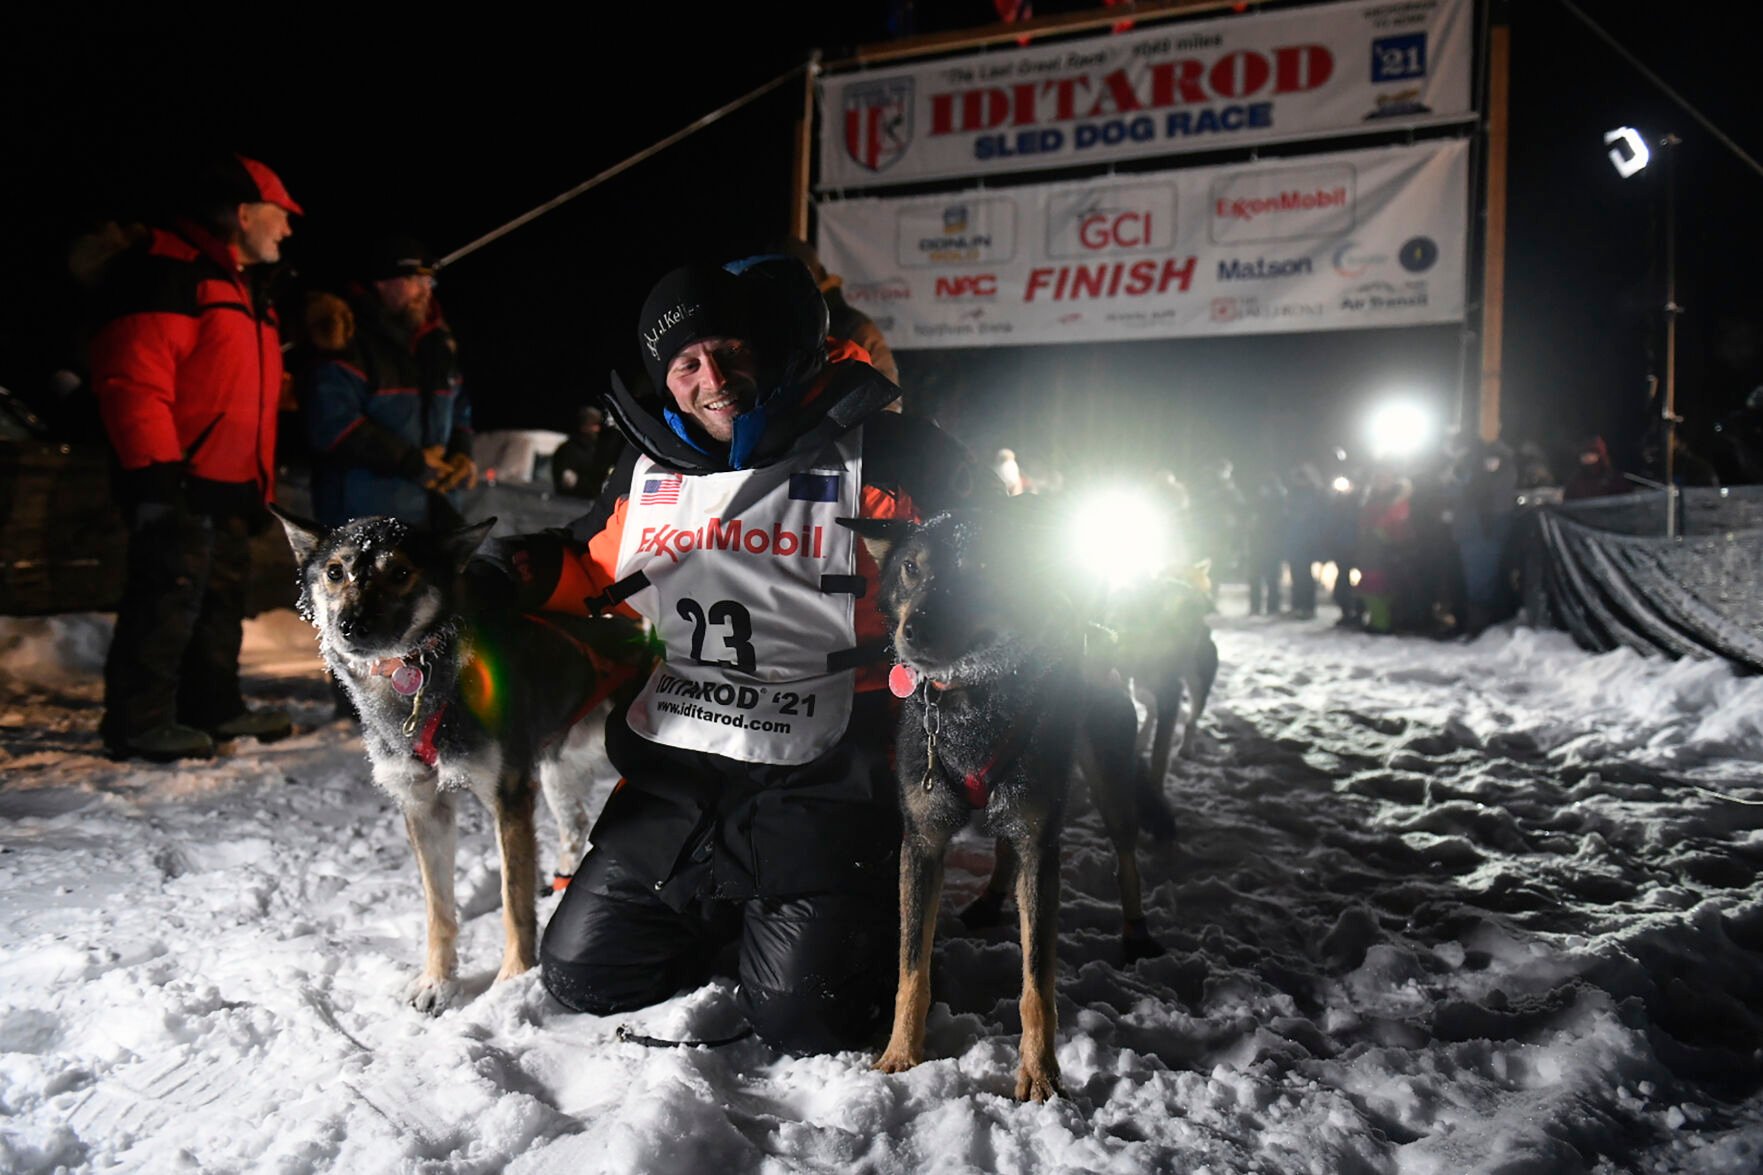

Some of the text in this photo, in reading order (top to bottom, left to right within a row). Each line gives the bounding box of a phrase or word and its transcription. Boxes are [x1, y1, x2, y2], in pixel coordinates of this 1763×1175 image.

[928, 43, 1335, 137] IDITAROD
[974, 101, 1274, 161] SLED DOG RACE
[1214, 186, 1347, 220] ExxonMobil
[1078, 209, 1153, 252] GCI
[1023, 255, 1199, 304] FINISH
[1217, 255, 1313, 283] Matson
[676, 598, 756, 675] 23
[656, 700, 791, 734] www.iditarod.com
